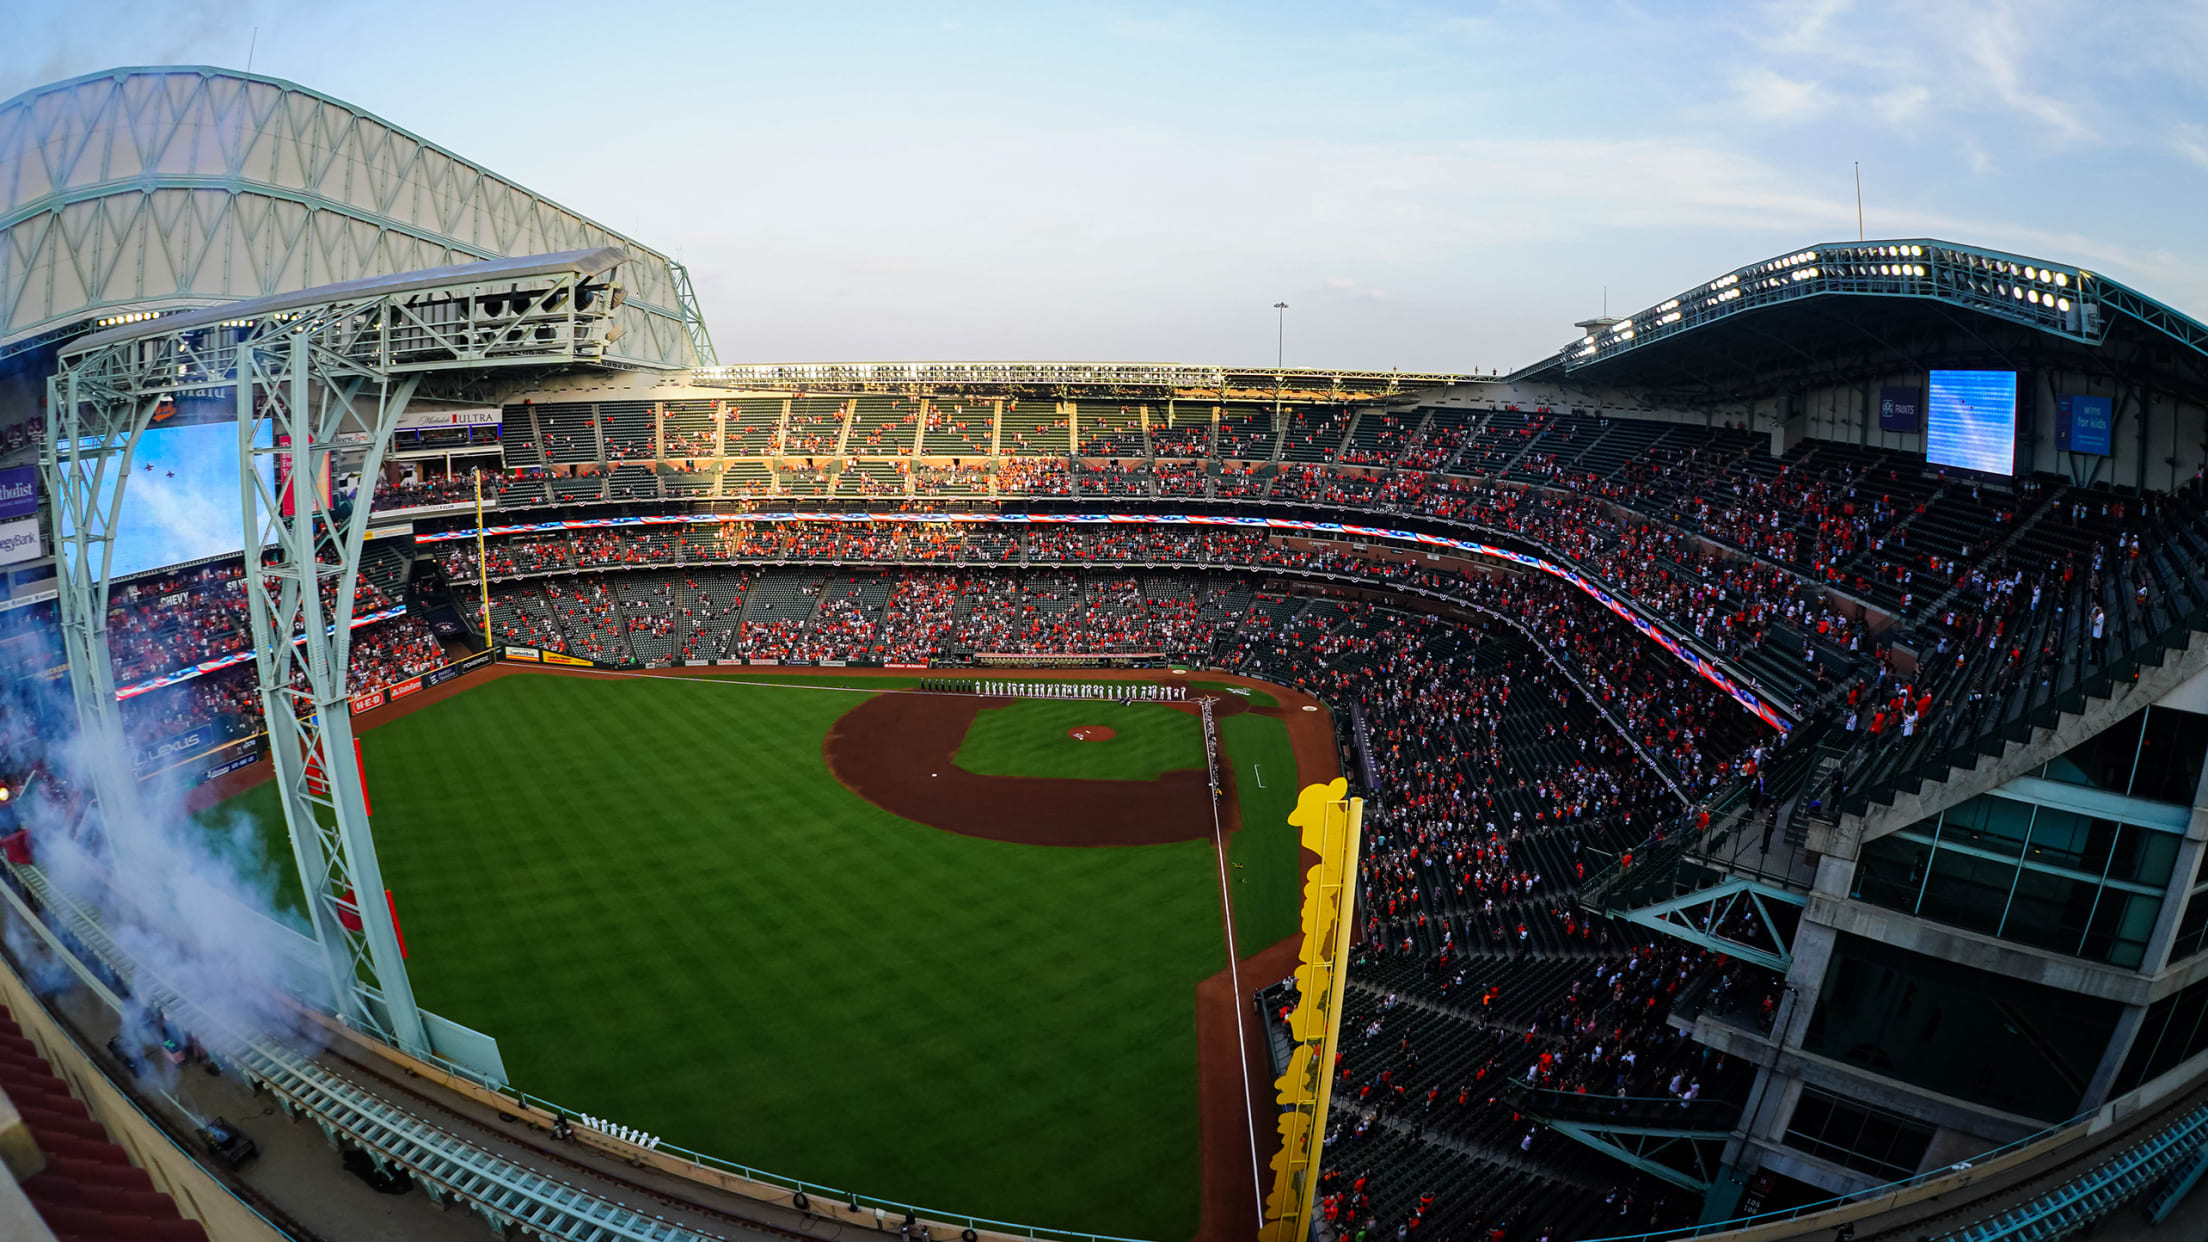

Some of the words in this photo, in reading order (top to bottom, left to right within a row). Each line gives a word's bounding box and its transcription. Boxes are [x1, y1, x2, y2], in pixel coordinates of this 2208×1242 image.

[1895, 404, 1915, 415] PAINTS
[458, 413, 493, 423] ULTRA
[160, 591, 190, 607] CHEVY
[356, 695, 380, 710] H-E-B
[148, 734, 200, 760] LEXUS
